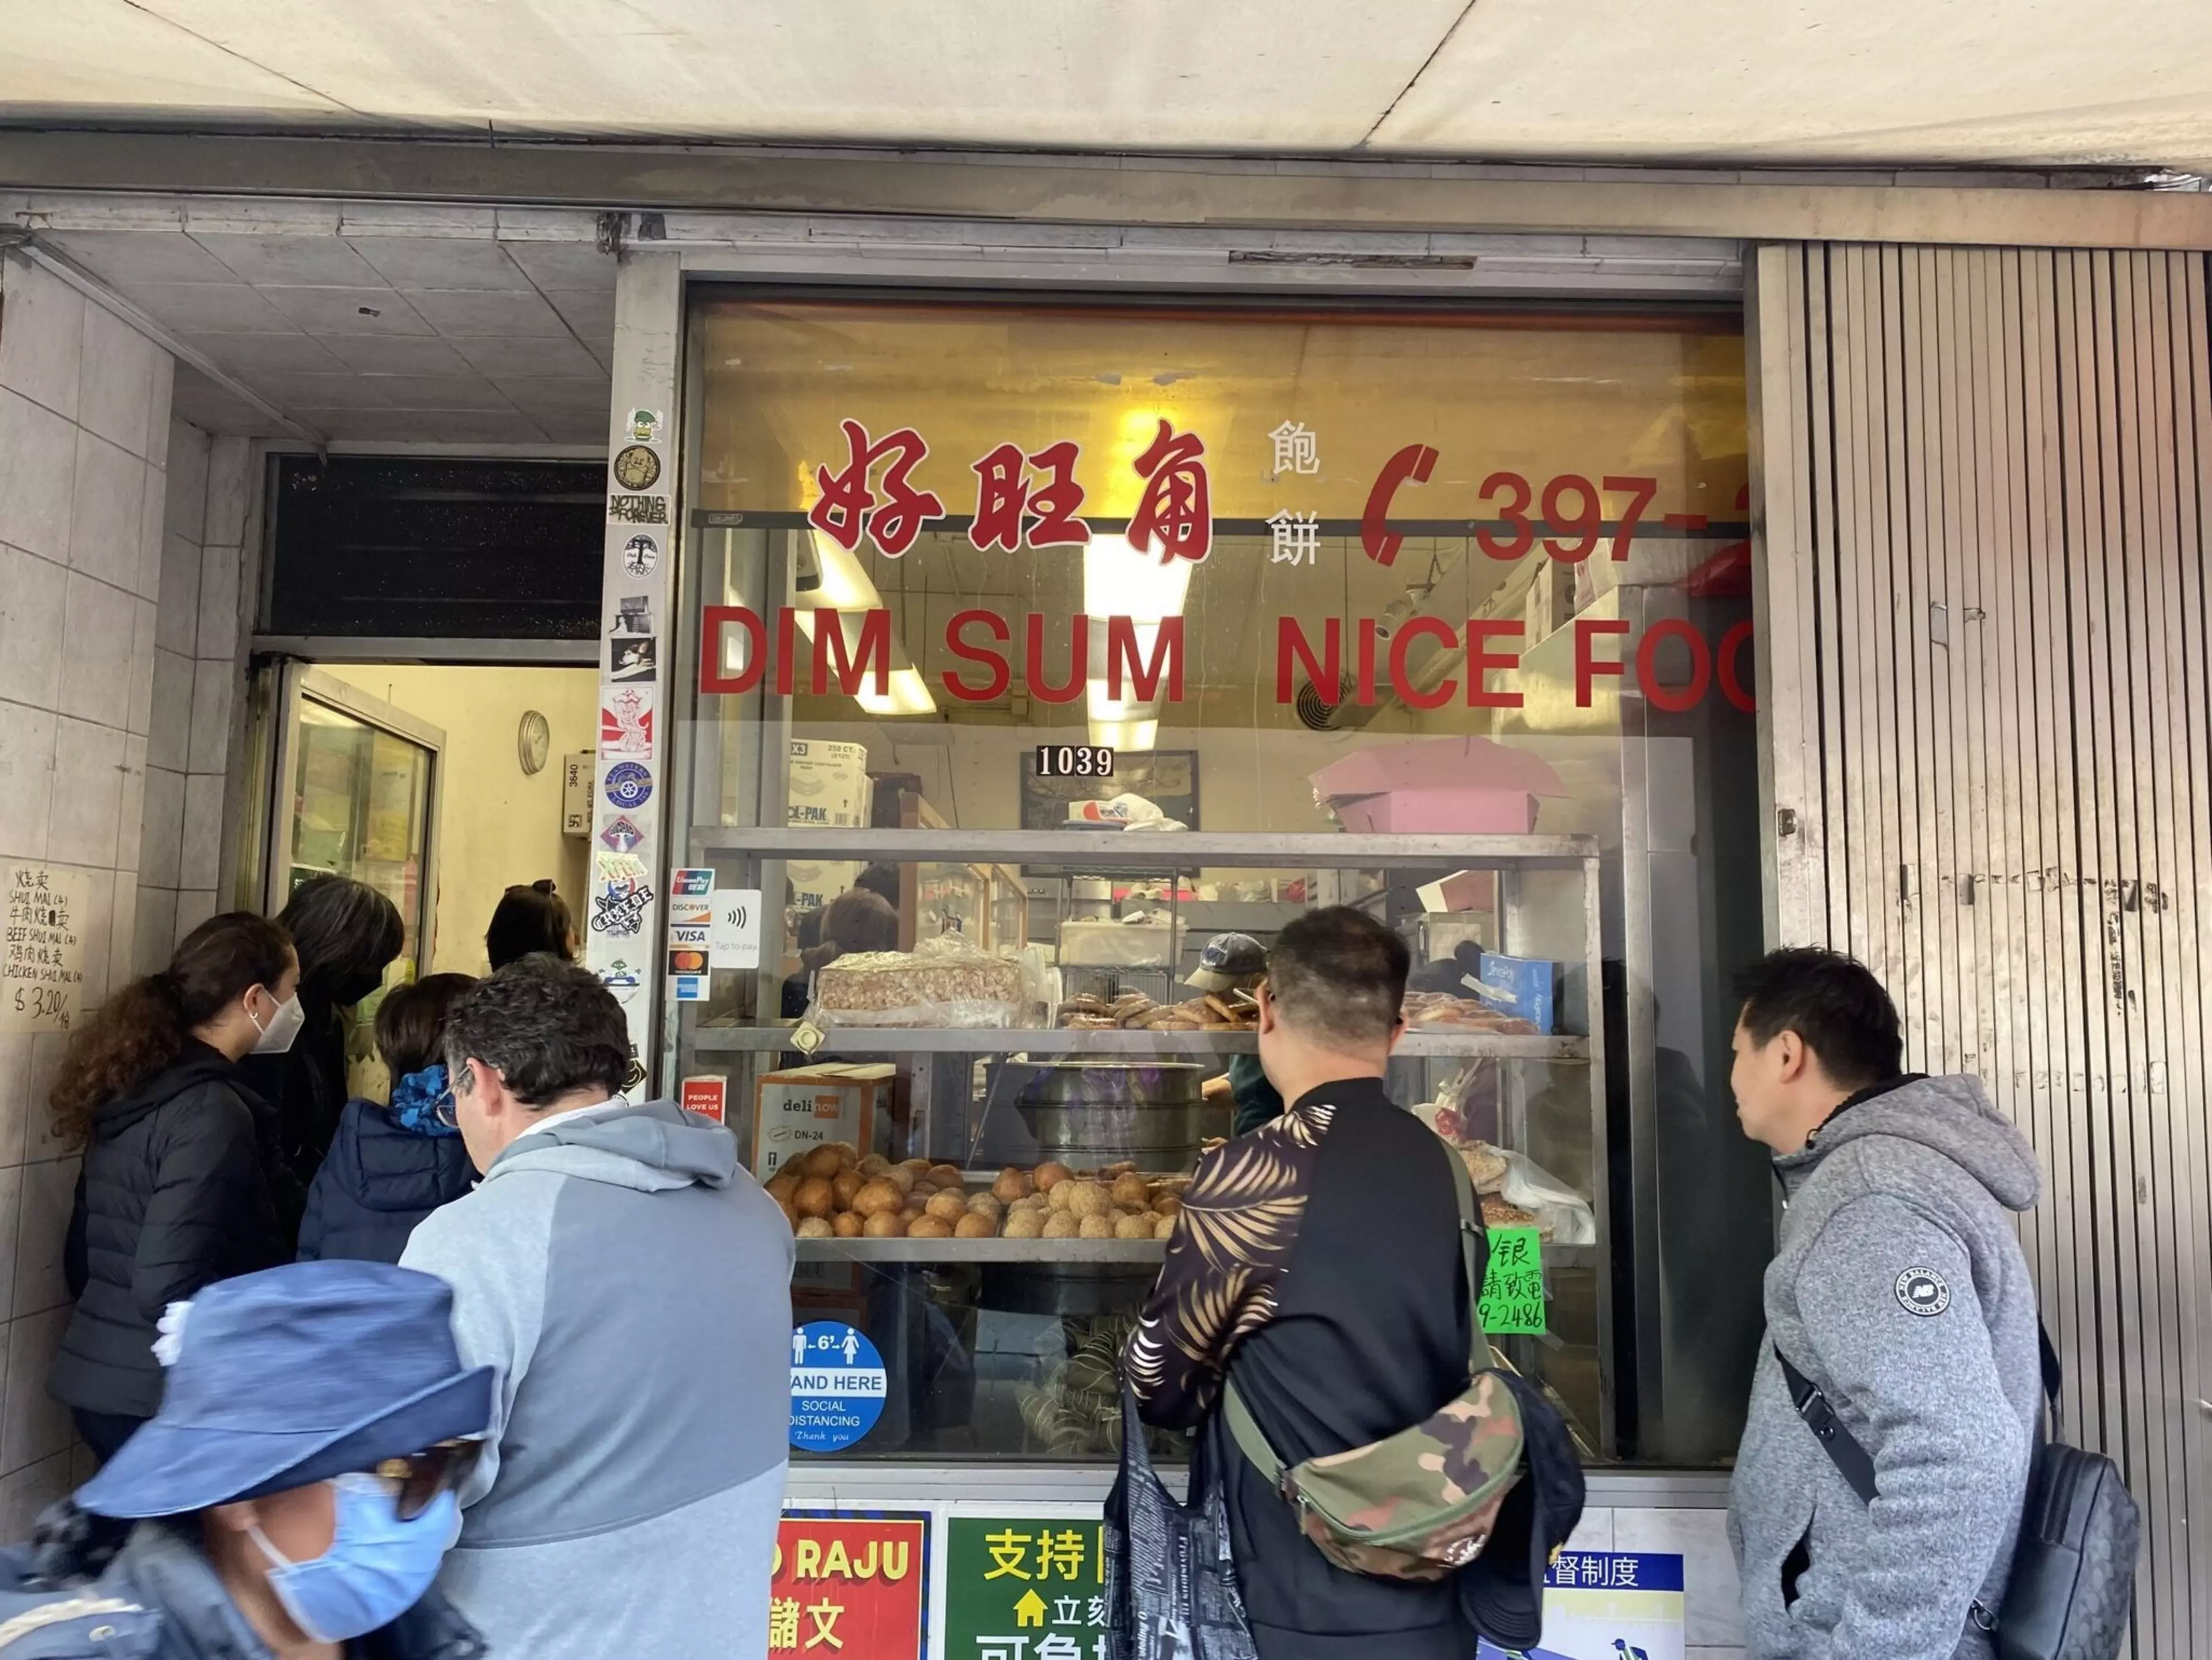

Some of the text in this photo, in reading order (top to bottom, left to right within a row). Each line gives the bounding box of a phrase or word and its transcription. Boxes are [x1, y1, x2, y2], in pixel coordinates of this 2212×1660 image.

[807, 418, 1214, 566] 好旺角
[699, 606, 891, 696] DIM
[942, 610, 1185, 704] SUM
[1275, 616, 1525, 710] NICE
[1040, 747, 1112, 776] 1039
[672, 903, 709, 912] DISCOVER
[6, 927, 28, 943] BEEF
[676, 931, 705, 942] VISA
[715, 942, 730, 951] Tap
[2, 963, 39, 981] CHICKEN
[783, 1099, 812, 1113] deli
[794, 1130, 824, 1140] DN-24
[1479, 1301, 1543, 1328] 9-2486
[790, 1375, 882, 1390] AND HERE
[801, 1400, 846, 1412] SOCIAL
[795, 1431, 849, 1442] Thank you
[797, 1540, 909, 1580] RAJU
[983, 1527, 1104, 1585] 支持
[1543, 1555, 1639, 1586] 督制度
